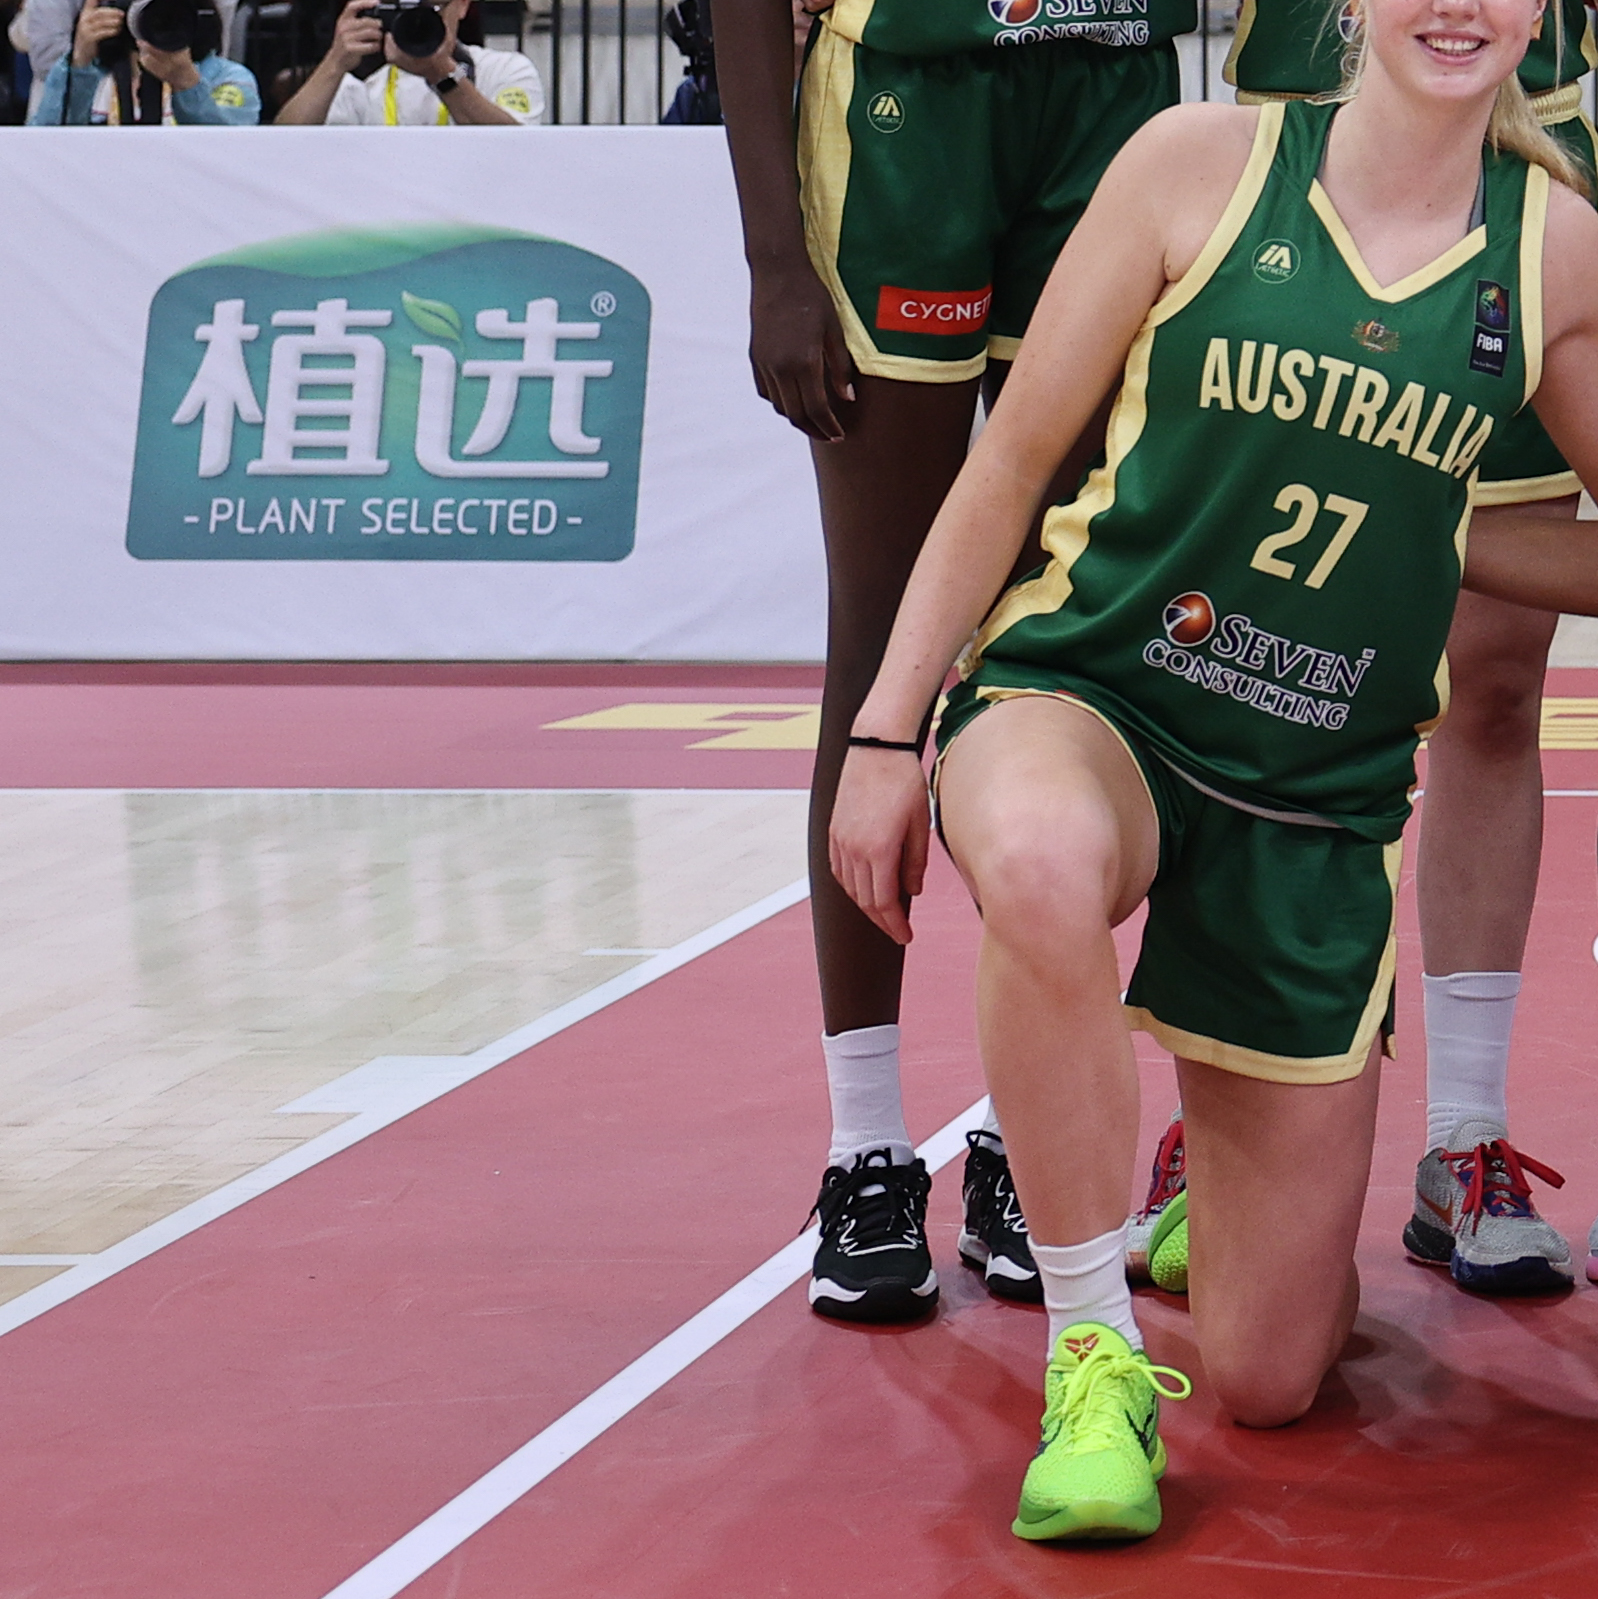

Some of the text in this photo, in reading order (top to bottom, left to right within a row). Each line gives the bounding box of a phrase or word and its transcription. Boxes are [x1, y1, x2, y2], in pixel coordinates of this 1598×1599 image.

[171, 298, 613, 479] 植选
[1476, 333, 1503, 353] FIBA
[1199, 337, 1495, 478] AUSTRALIA
[210, 499, 557, 534] PLANT SELECTED
[1249, 483, 1370, 590] 27
[1143, 639, 1350, 731] CONSULTING
[1212, 613, 1370, 697] SEVEN
